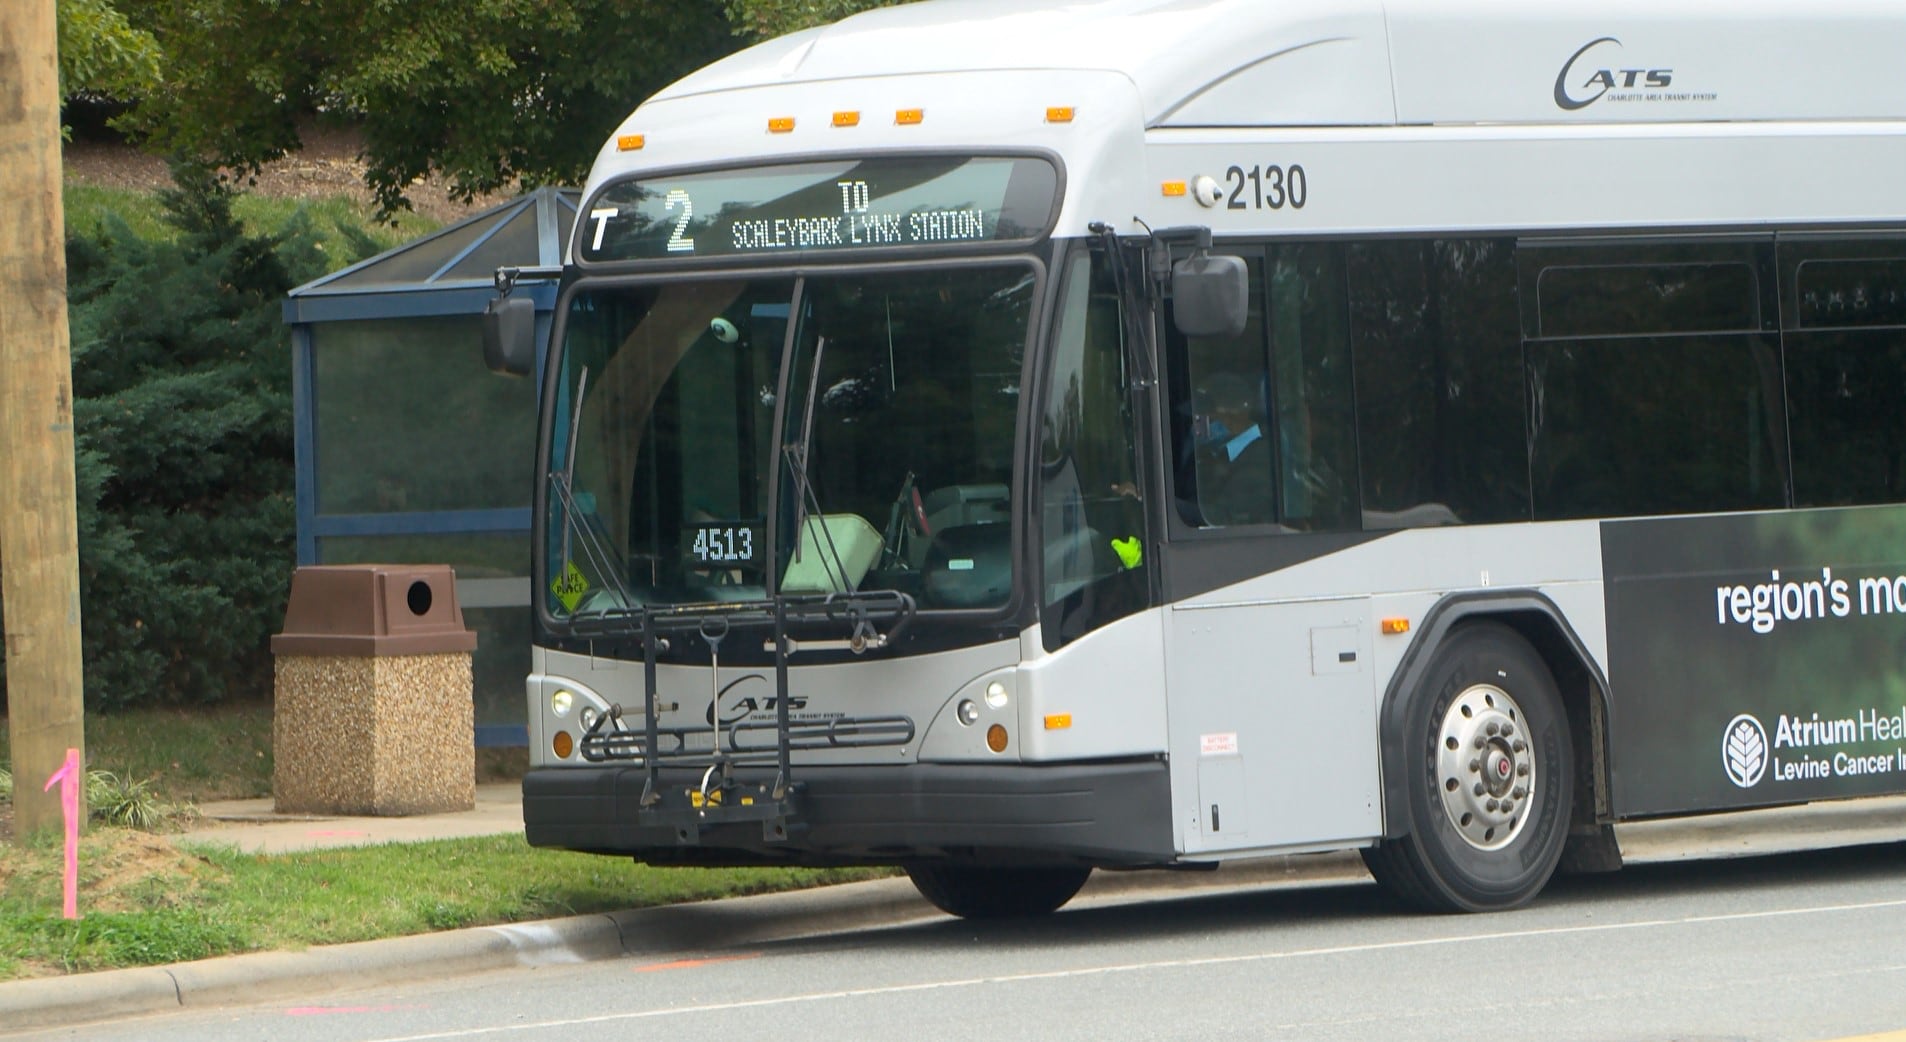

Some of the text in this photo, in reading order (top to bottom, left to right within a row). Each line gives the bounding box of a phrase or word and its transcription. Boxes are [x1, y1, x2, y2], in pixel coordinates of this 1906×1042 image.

[1554, 37, 1673, 110] CATS
[1607, 92, 1718, 102] CHARLOTTE AREA TRANSIT SYSTEM
[838, 181, 870, 213] TO
[1226, 164, 1307, 209] 2130
[591, 207, 619, 251] T
[664, 189, 695, 252] 2
[732, 209, 984, 249] SCALEYBARK LYNX STATION
[693, 527, 752, 561] 4513
[1716, 567, 1850, 634] region's
[750, 713, 780, 722] CHARLOTT
[1774, 713, 1855, 749] Atrium
[1774, 755, 1830, 781] Levine
[1833, 752, 1894, 777] Cancer
